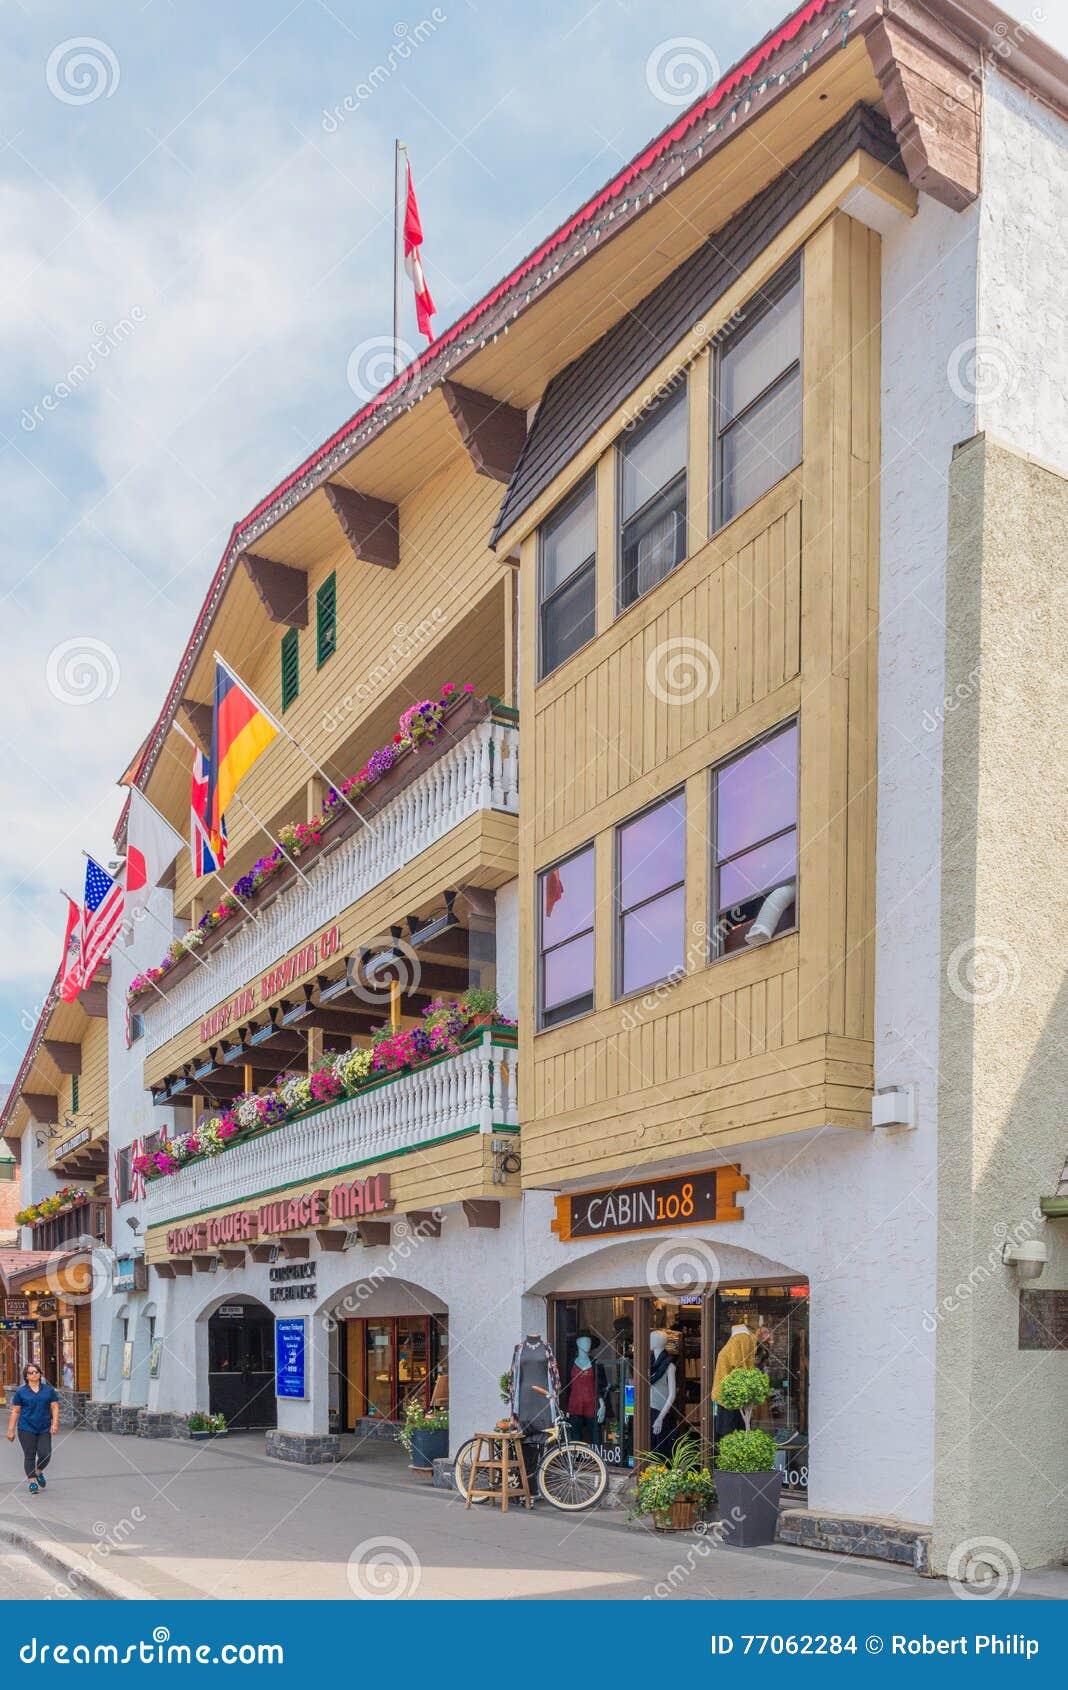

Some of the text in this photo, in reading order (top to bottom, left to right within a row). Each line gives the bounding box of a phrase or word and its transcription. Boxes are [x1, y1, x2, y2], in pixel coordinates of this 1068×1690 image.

[261, 943, 317, 1002] BREWING
[166, 1224, 201, 1254] CLOCK
[206, 1210, 251, 1245] TOWER
[258, 1191, 322, 1235] VILLAGE
